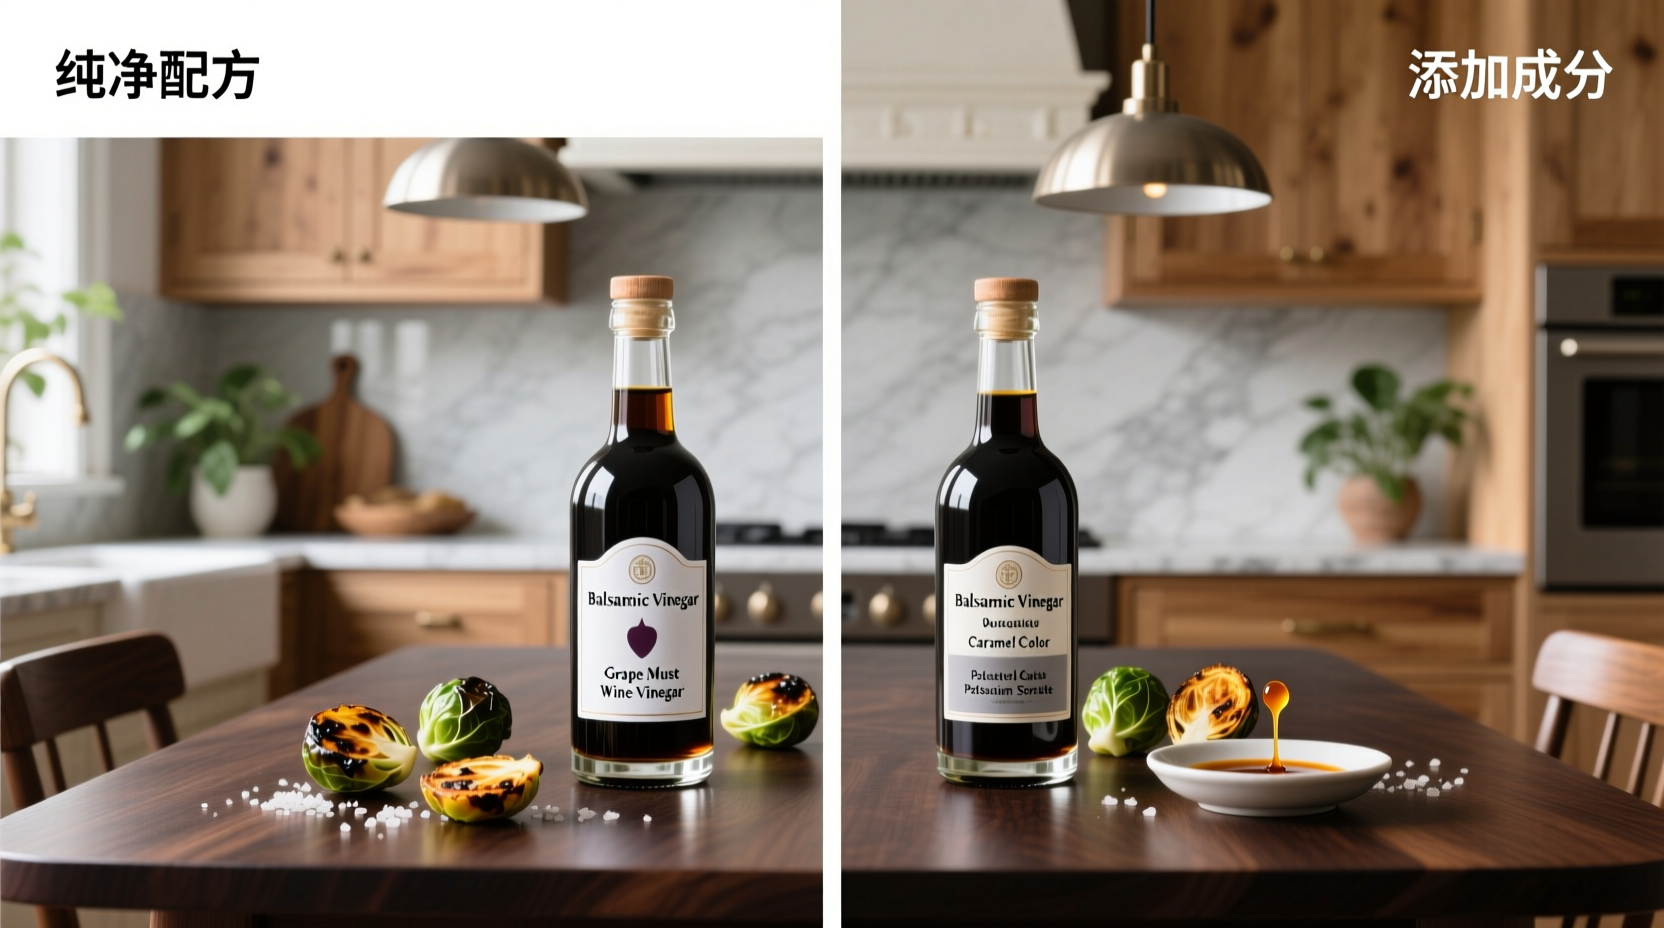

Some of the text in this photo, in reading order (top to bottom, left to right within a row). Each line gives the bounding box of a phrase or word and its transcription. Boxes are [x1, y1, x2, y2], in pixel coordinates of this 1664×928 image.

[588, 591, 699, 611] Balsamic Vinegar
[956, 593, 1063, 611] Balsamic Vinegar
[968, 635, 1051, 649] Caramel Color
[604, 666, 679, 683] Grape Must
[600, 684, 685, 702] Wine Vinegar
